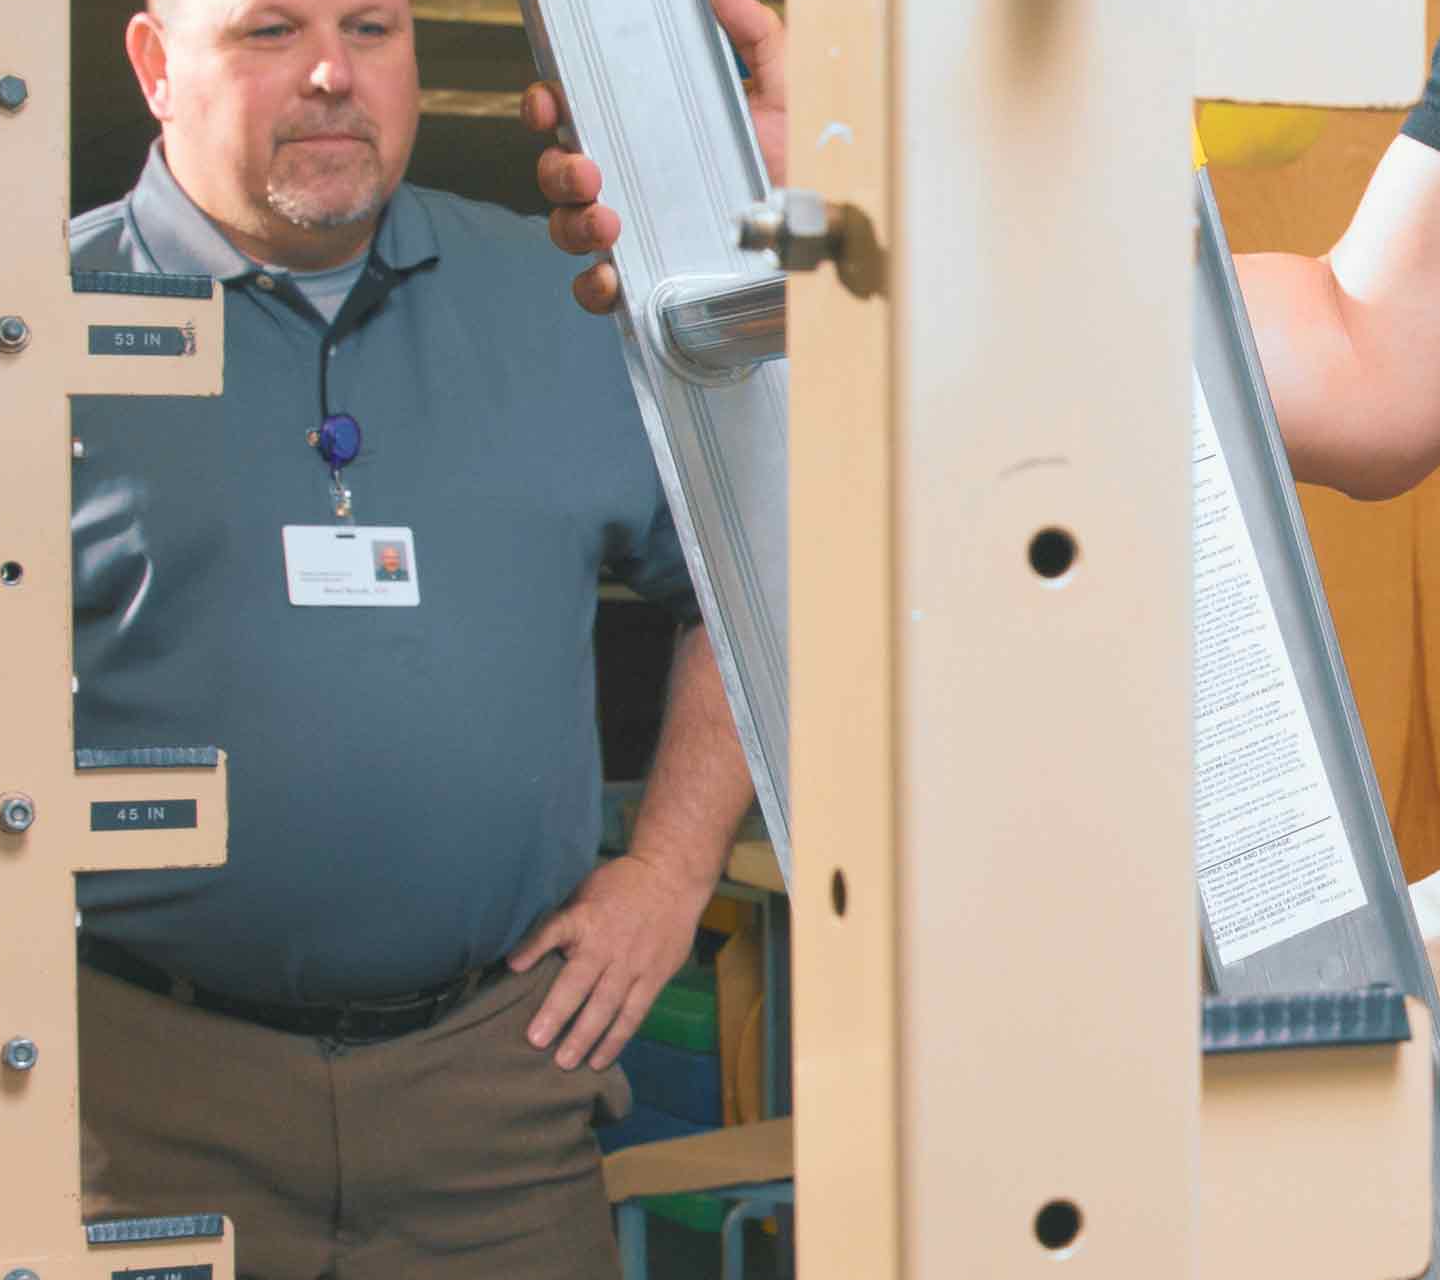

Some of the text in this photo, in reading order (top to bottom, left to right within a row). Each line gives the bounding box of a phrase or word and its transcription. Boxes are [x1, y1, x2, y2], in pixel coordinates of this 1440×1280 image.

[114, 333, 161, 346] 53 IN
[117, 807, 165, 821] 45 IN
